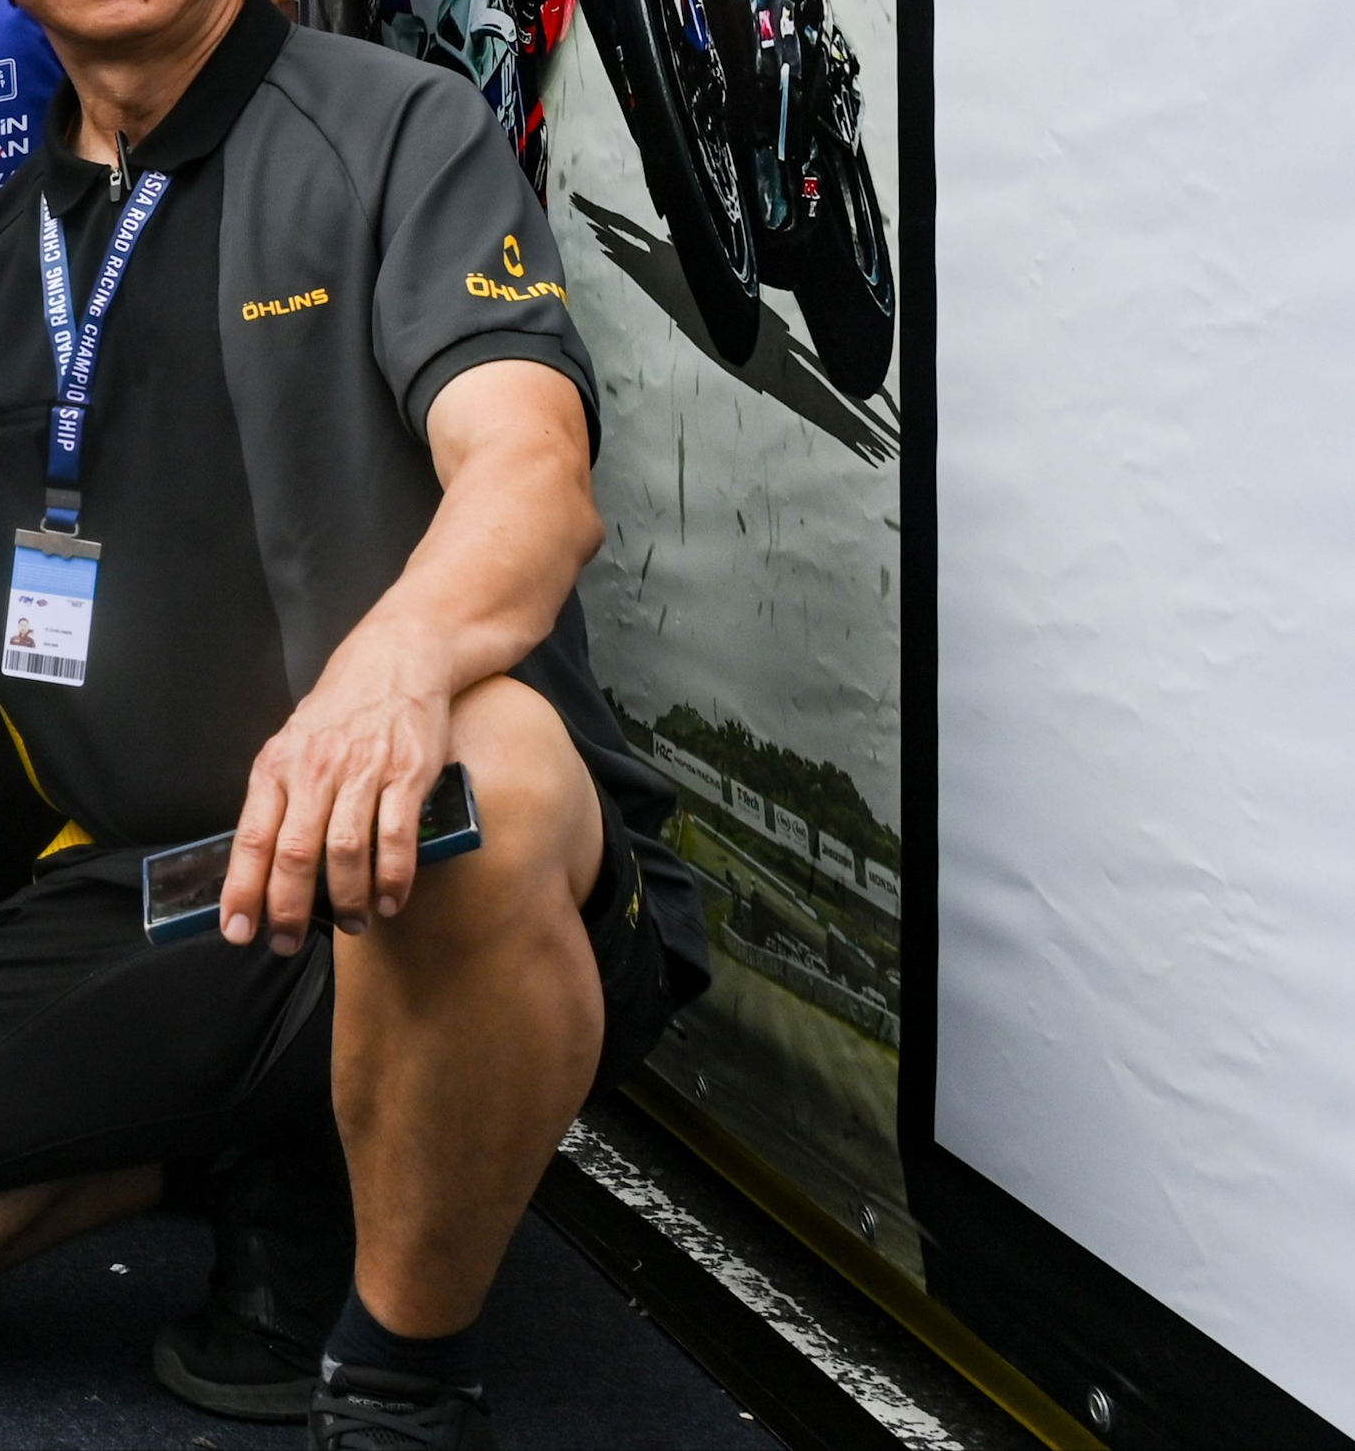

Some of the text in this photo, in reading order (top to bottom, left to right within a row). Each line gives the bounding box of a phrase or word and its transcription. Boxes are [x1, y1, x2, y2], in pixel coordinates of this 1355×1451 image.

[112, 205, 147, 254] ROAD
[46, 264, 70, 328] RACING
[89, 255, 125, 318] RACING
[242, 287, 329, 321] ÖHLINS
